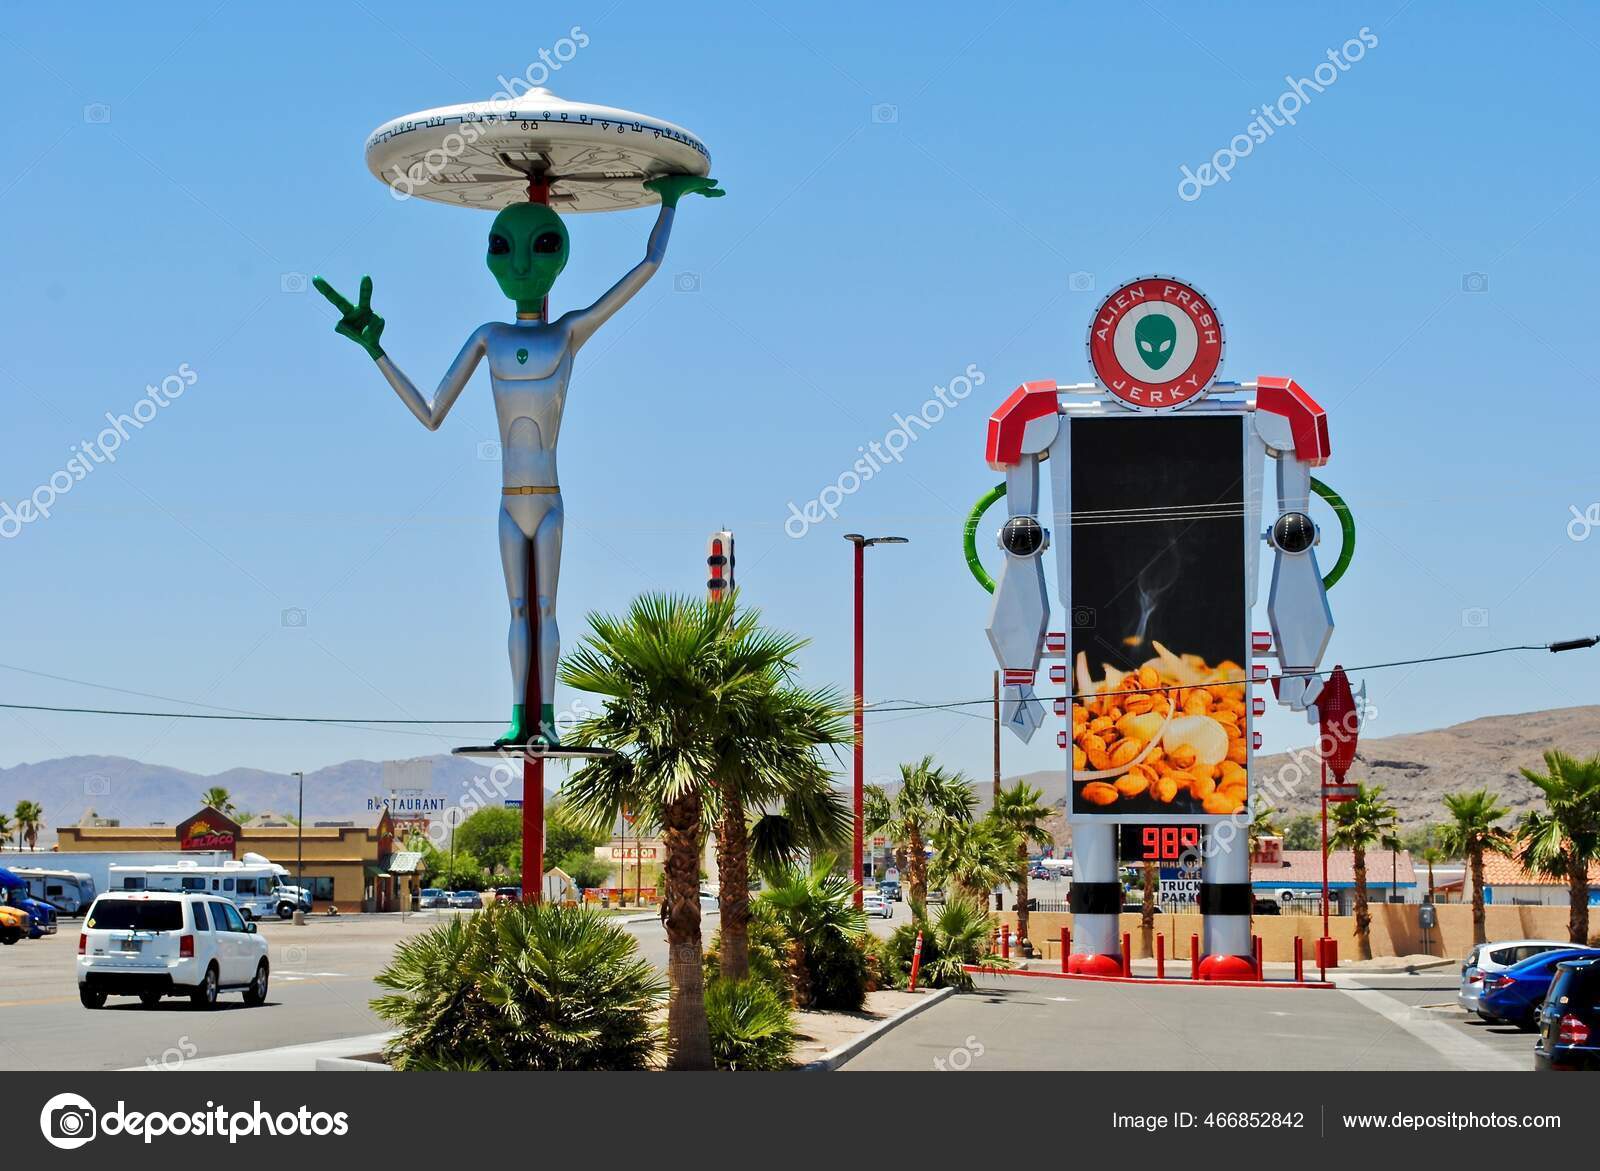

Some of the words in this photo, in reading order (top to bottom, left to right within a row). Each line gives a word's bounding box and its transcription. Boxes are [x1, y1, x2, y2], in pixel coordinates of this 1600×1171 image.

[1097, 287, 1145, 341] ALIEN
[1164, 286, 1217, 344] FRESH
[1113, 374, 1198, 402] JERKY
[1161, 881, 1201, 891] TRUCK
